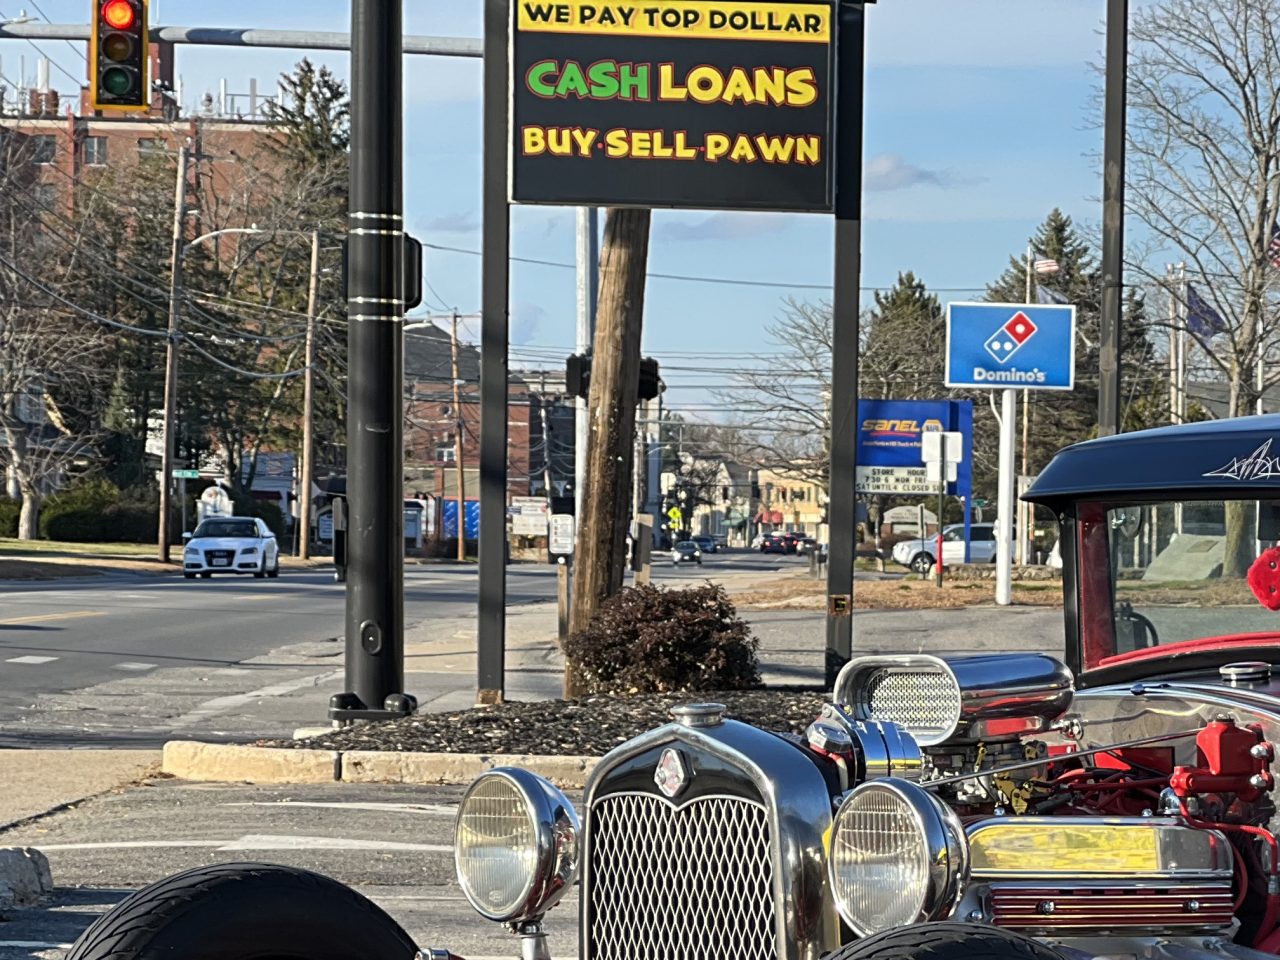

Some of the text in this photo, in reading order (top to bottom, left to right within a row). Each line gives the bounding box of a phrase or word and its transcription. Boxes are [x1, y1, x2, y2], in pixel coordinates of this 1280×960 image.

[524, 3, 822, 33] WE PAY TOP DOLLAR
[526, 60, 817, 106] CASH LOANS
[522, 126, 822, 164] BUY SELL PAWN
[973, 367, 1046, 383] Domino's
[902, 484, 930, 492] CLOSED
